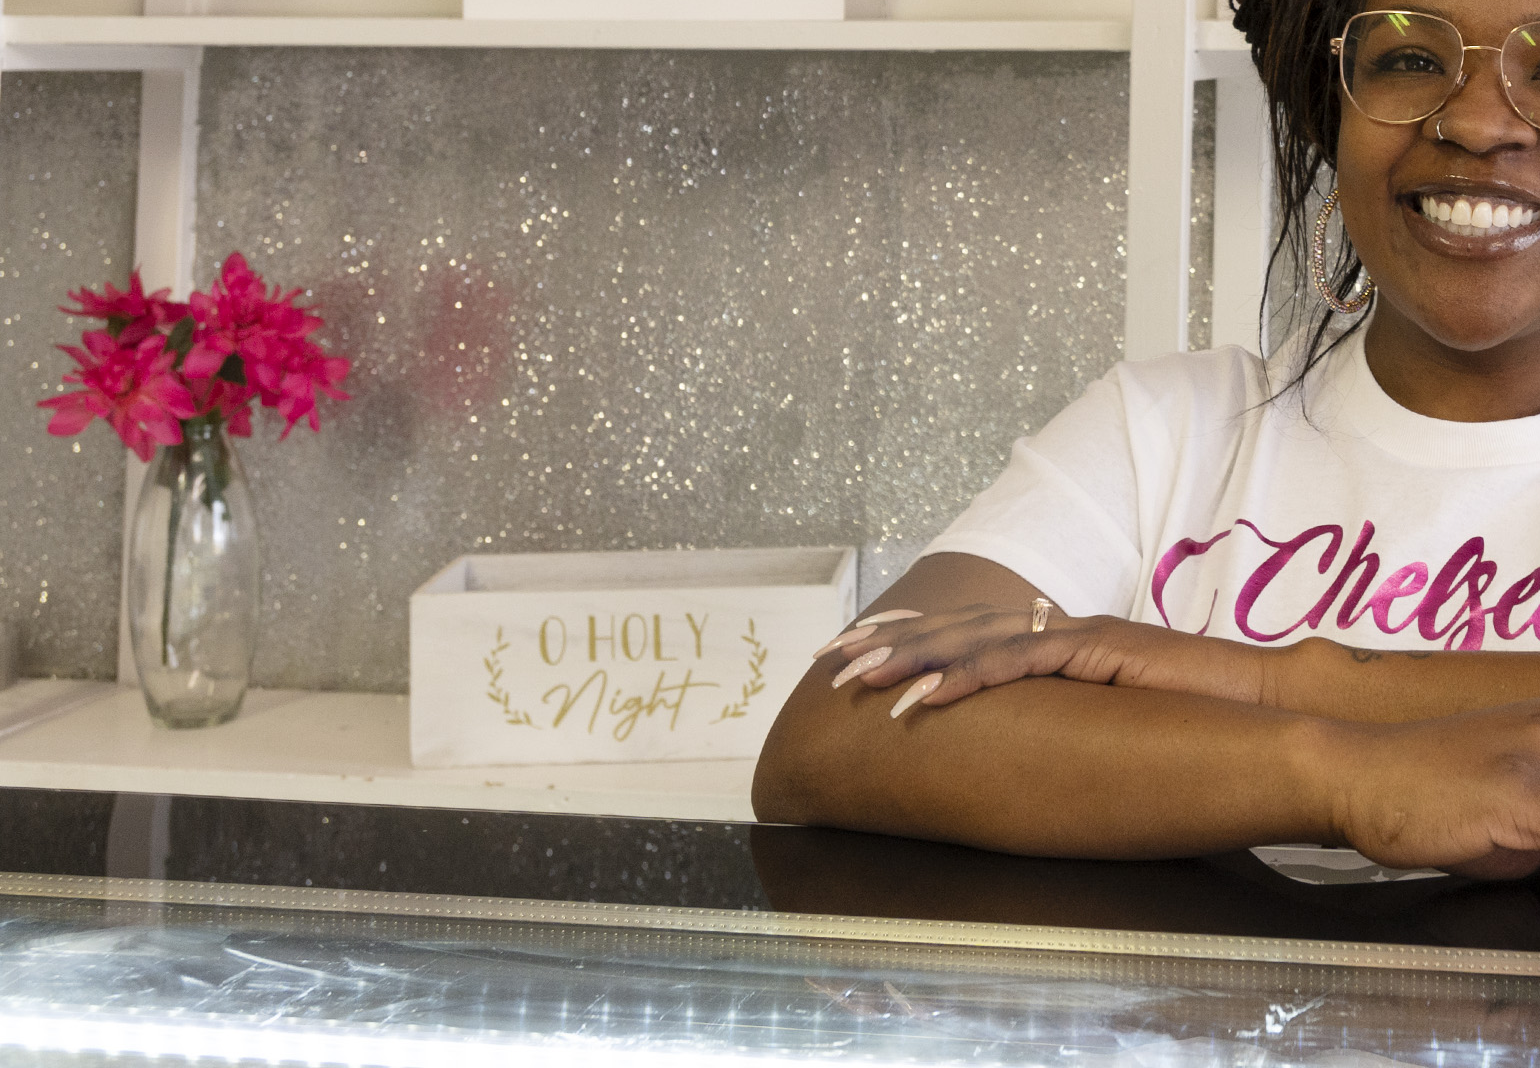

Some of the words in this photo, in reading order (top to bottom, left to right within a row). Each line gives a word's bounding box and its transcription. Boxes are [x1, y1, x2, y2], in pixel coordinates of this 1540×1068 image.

[538, 615, 567, 666] O
[587, 612, 709, 663] HOLY
[541, 668, 721, 743] Night
